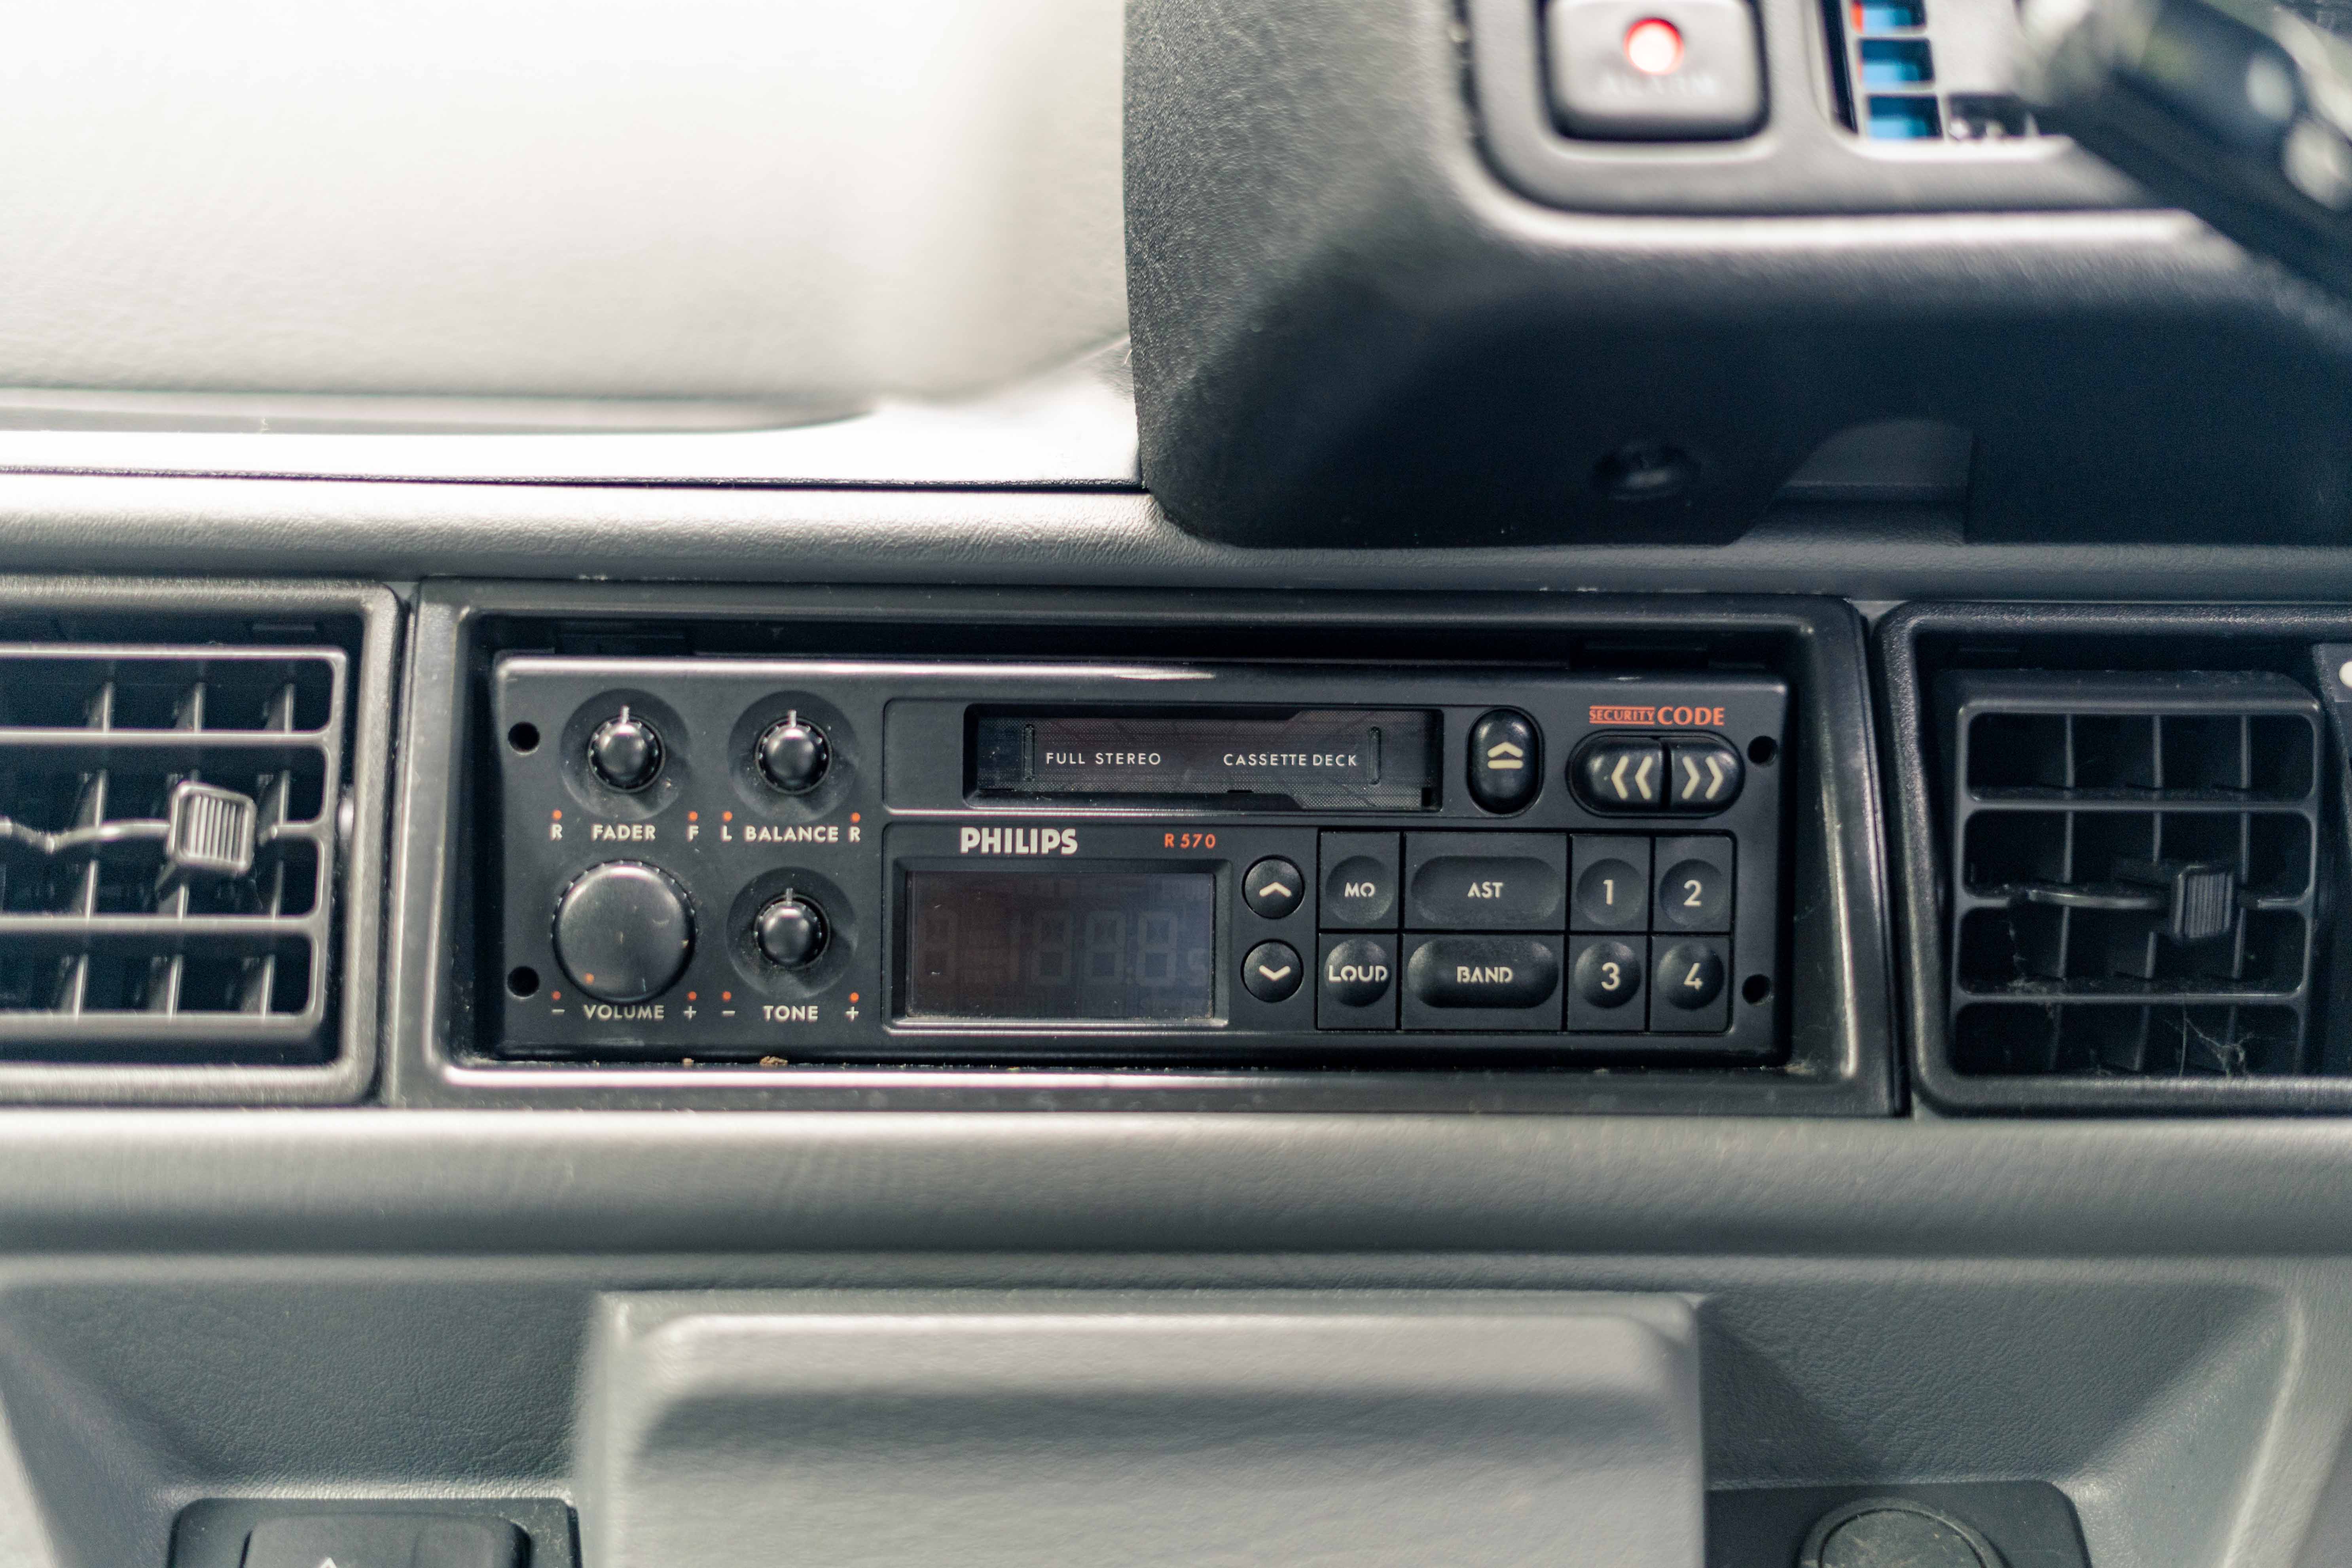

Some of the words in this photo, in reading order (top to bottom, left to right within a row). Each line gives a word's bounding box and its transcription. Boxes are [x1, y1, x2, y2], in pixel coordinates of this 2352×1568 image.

[1590, 708, 1655, 723] SECURITY
[1657, 706, 1725, 726] CODE
[1046, 752, 1086, 765] FULL
[1095, 752, 1161, 766] STEREO
[1223, 753, 1307, 766] CASSETTE
[1312, 754, 1357, 767] DECK
[550, 823, 563, 840] R
[591, 823, 656, 841] FADER
[687, 824, 699, 842] F
[721, 825, 733, 842] L
[744, 825, 839, 843] BALANCE
[848, 826, 861, 843] R
[960, 827, 1078, 855] PHILIPS
[1164, 833, 1175, 848] R
[1180, 833, 1216, 849] 570
[1344, 882, 1376, 898] MO
[1467, 881, 1503, 899] AST
[1603, 879, 1614, 906] 1
[1683, 879, 1702, 906] 2
[1328, 965, 1388, 982] LOUD
[1456, 966, 1513, 983] BAND
[1601, 962, 1620, 990] 3
[1683, 962, 1703, 990] 4
[583, 1004, 665, 1021] VOLUME
[763, 1005, 818, 1022] TONE
